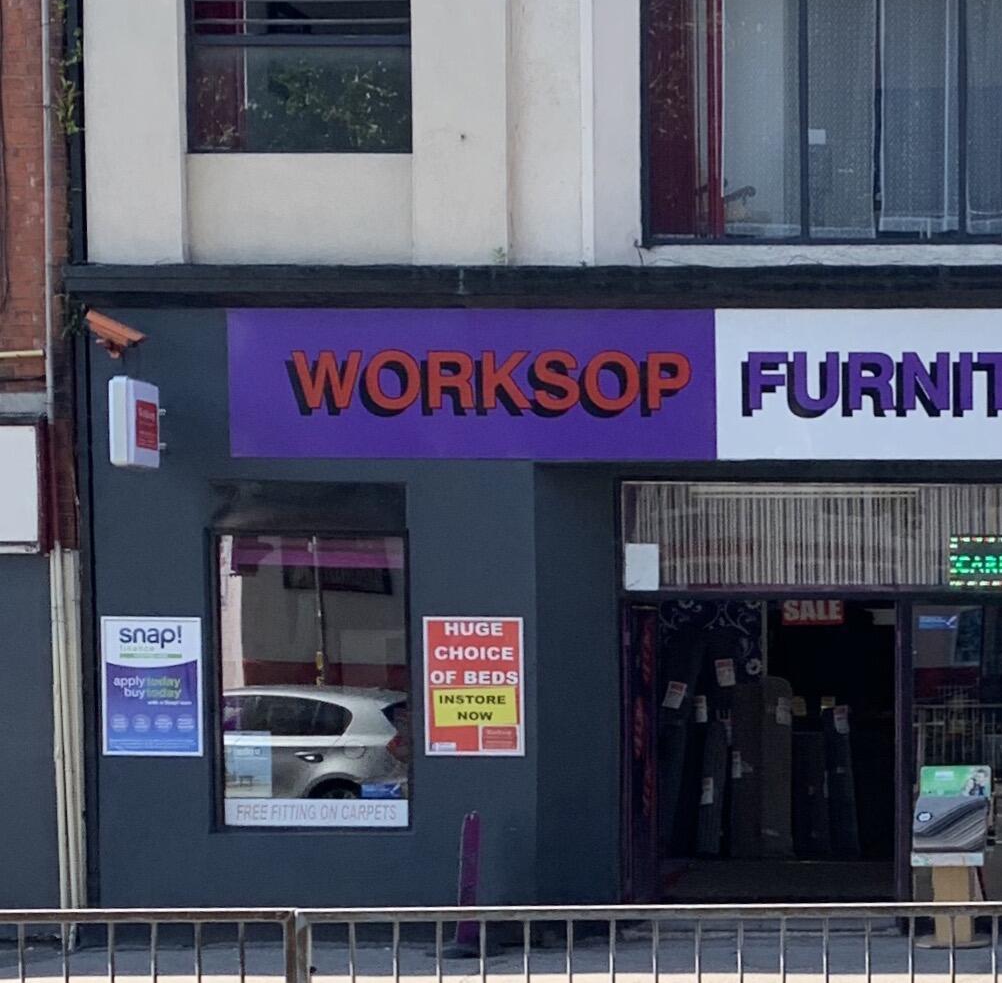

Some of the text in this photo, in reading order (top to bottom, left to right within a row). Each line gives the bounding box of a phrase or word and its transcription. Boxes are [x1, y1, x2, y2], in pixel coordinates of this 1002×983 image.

[286, 349, 692, 417] WORKSOP
[783, 600, 843, 621] SALE
[444, 622, 503, 636] HUGE
[119, 625, 182, 649] snap!
[434, 646, 514, 660] CHOICE
[113, 676, 145, 688] apply
[430, 670, 519, 685] OF BEDS
[124, 688, 145, 699] buy
[439, 694, 506, 705] INSTORE
[457, 711, 493, 721] NOW
[237, 804, 397, 820] FREE FITTING ON CARPETS
